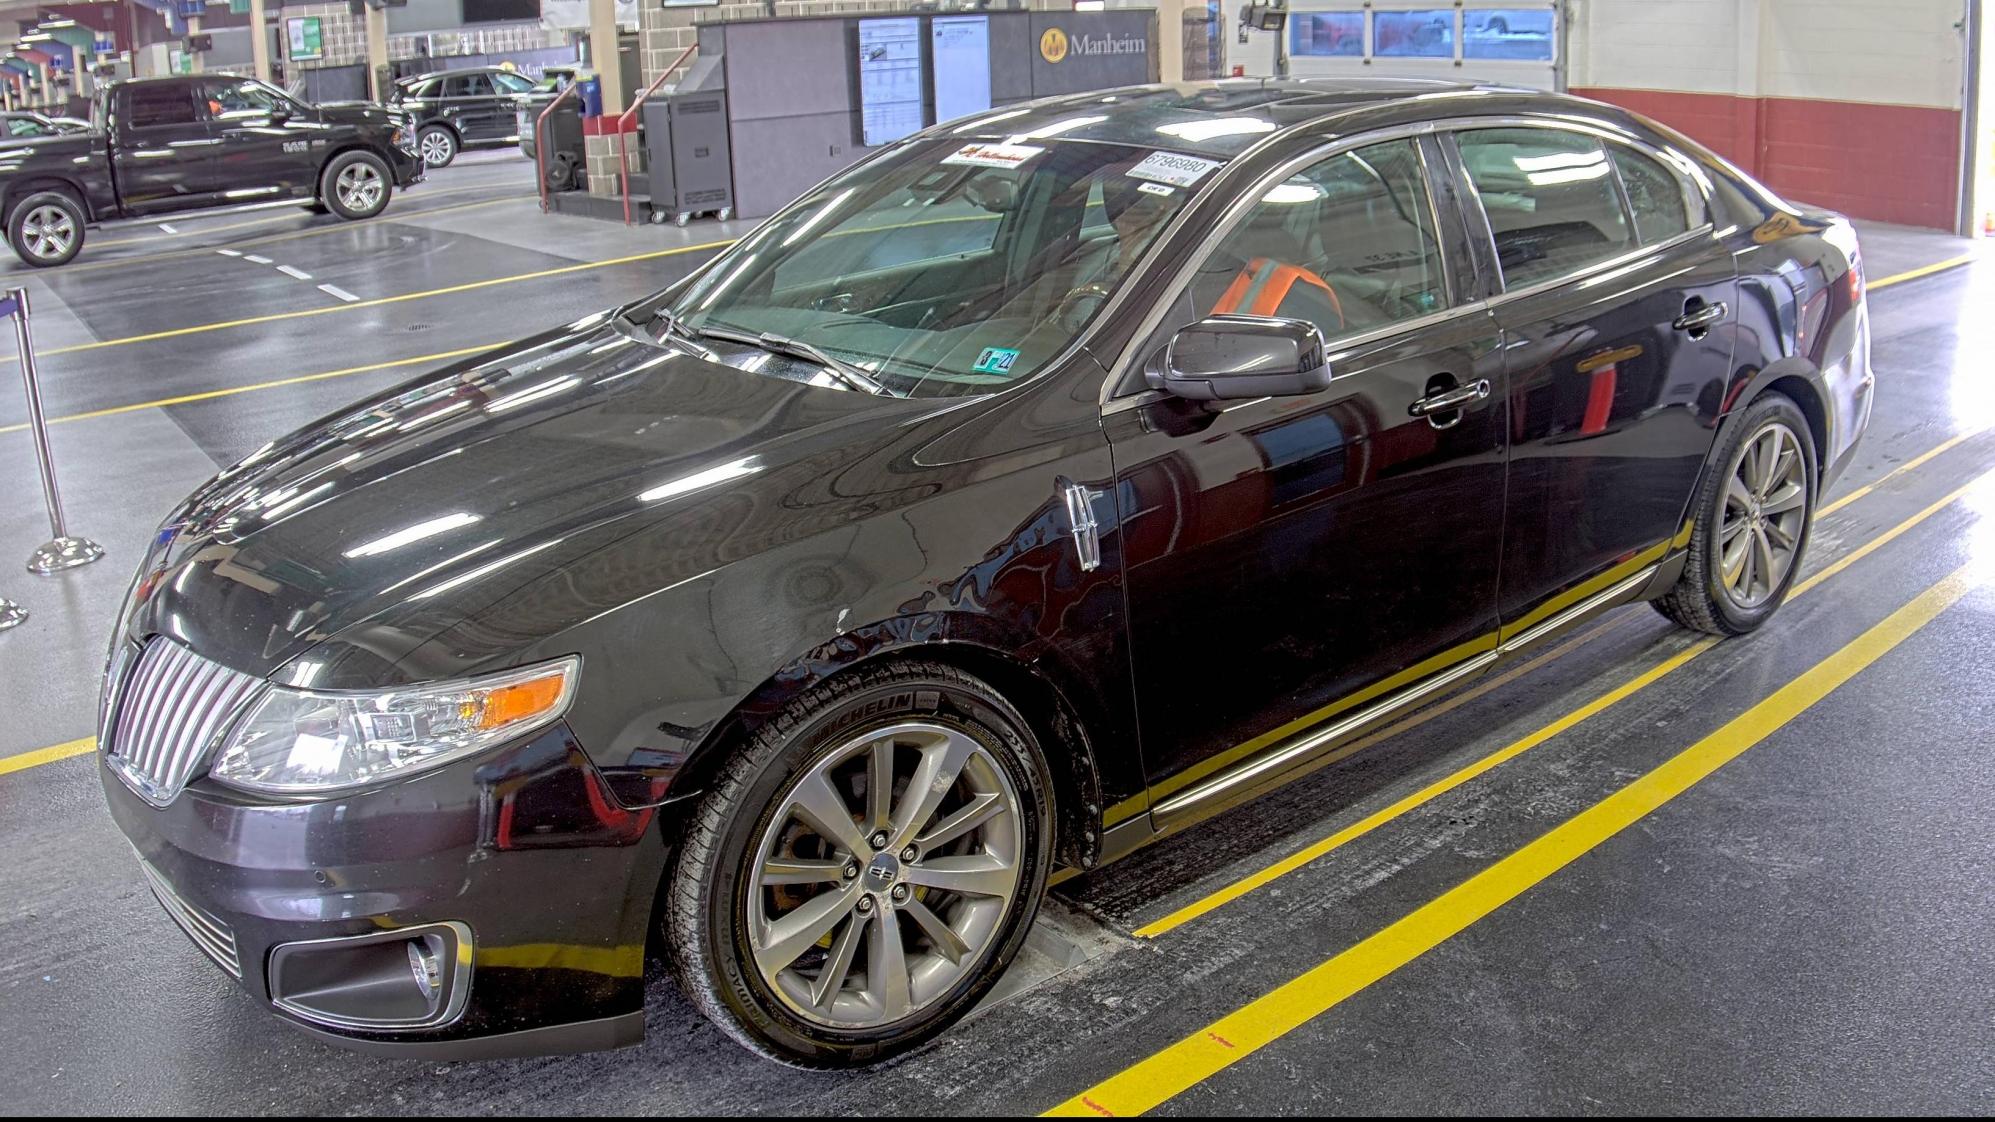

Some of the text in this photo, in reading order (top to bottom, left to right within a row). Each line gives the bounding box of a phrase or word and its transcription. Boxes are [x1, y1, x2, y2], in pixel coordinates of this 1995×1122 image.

[1070, 32, 1145, 55] Manheim
[1145, 154, 1207, 172] 6796980
[998, 352, 1016, 369] 21
